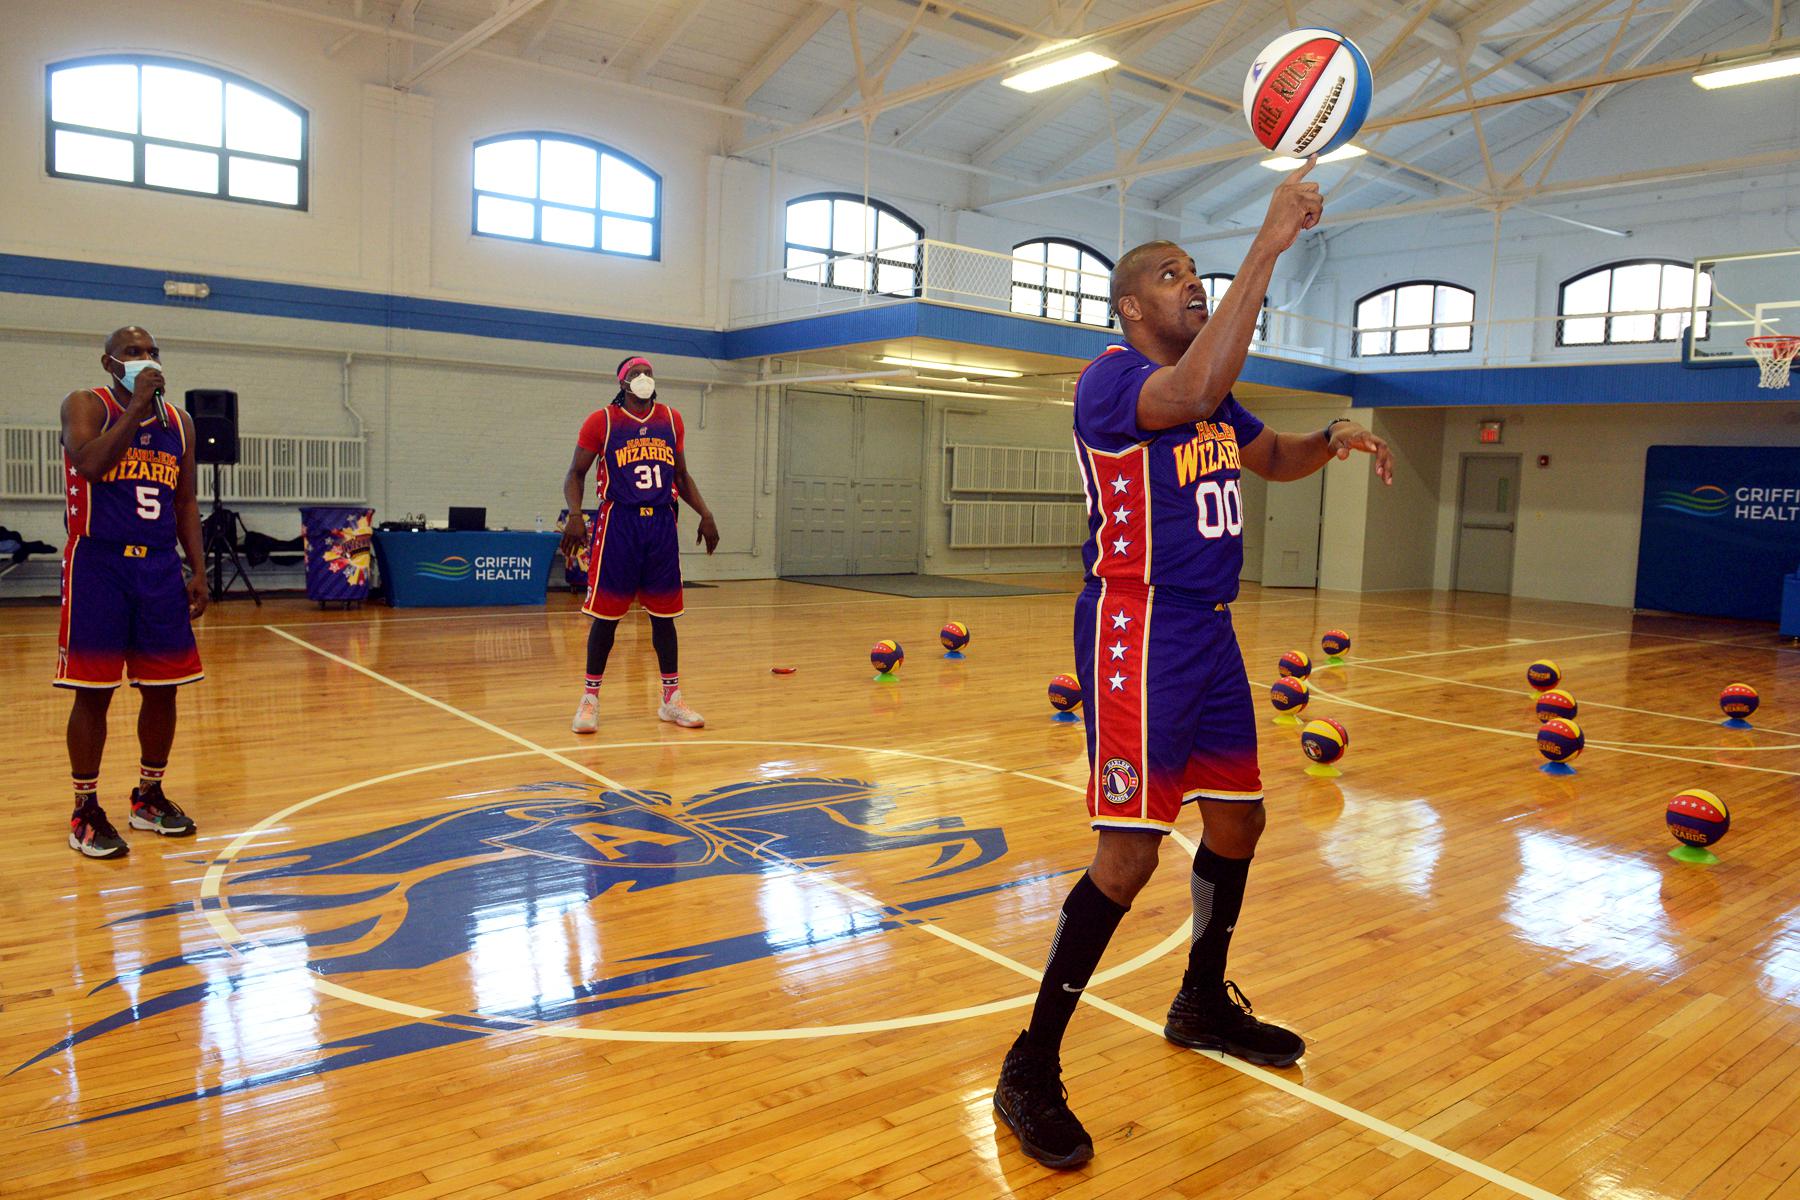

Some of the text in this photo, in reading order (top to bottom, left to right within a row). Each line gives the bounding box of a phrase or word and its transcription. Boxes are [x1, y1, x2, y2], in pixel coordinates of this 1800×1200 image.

[1257, 51, 1324, 136] THE ROCK
[1293, 75, 1346, 154] HARLEM WIZARDS
[626, 437, 667, 449] HARLEM
[614, 446, 676, 468] WIZARDS
[633, 464, 663, 489] 31
[135, 485, 162, 520] 5
[1734, 486, 1800, 503] GRIFFI
[1195, 479, 1243, 539] 00
[1734, 504, 1800, 521] HEALT
[474, 556, 532, 569] GRIFFIN
[475, 569, 531, 581] HEALTH
[568, 821, 695, 861] A
[1670, 827, 1708, 843] IZARDS
